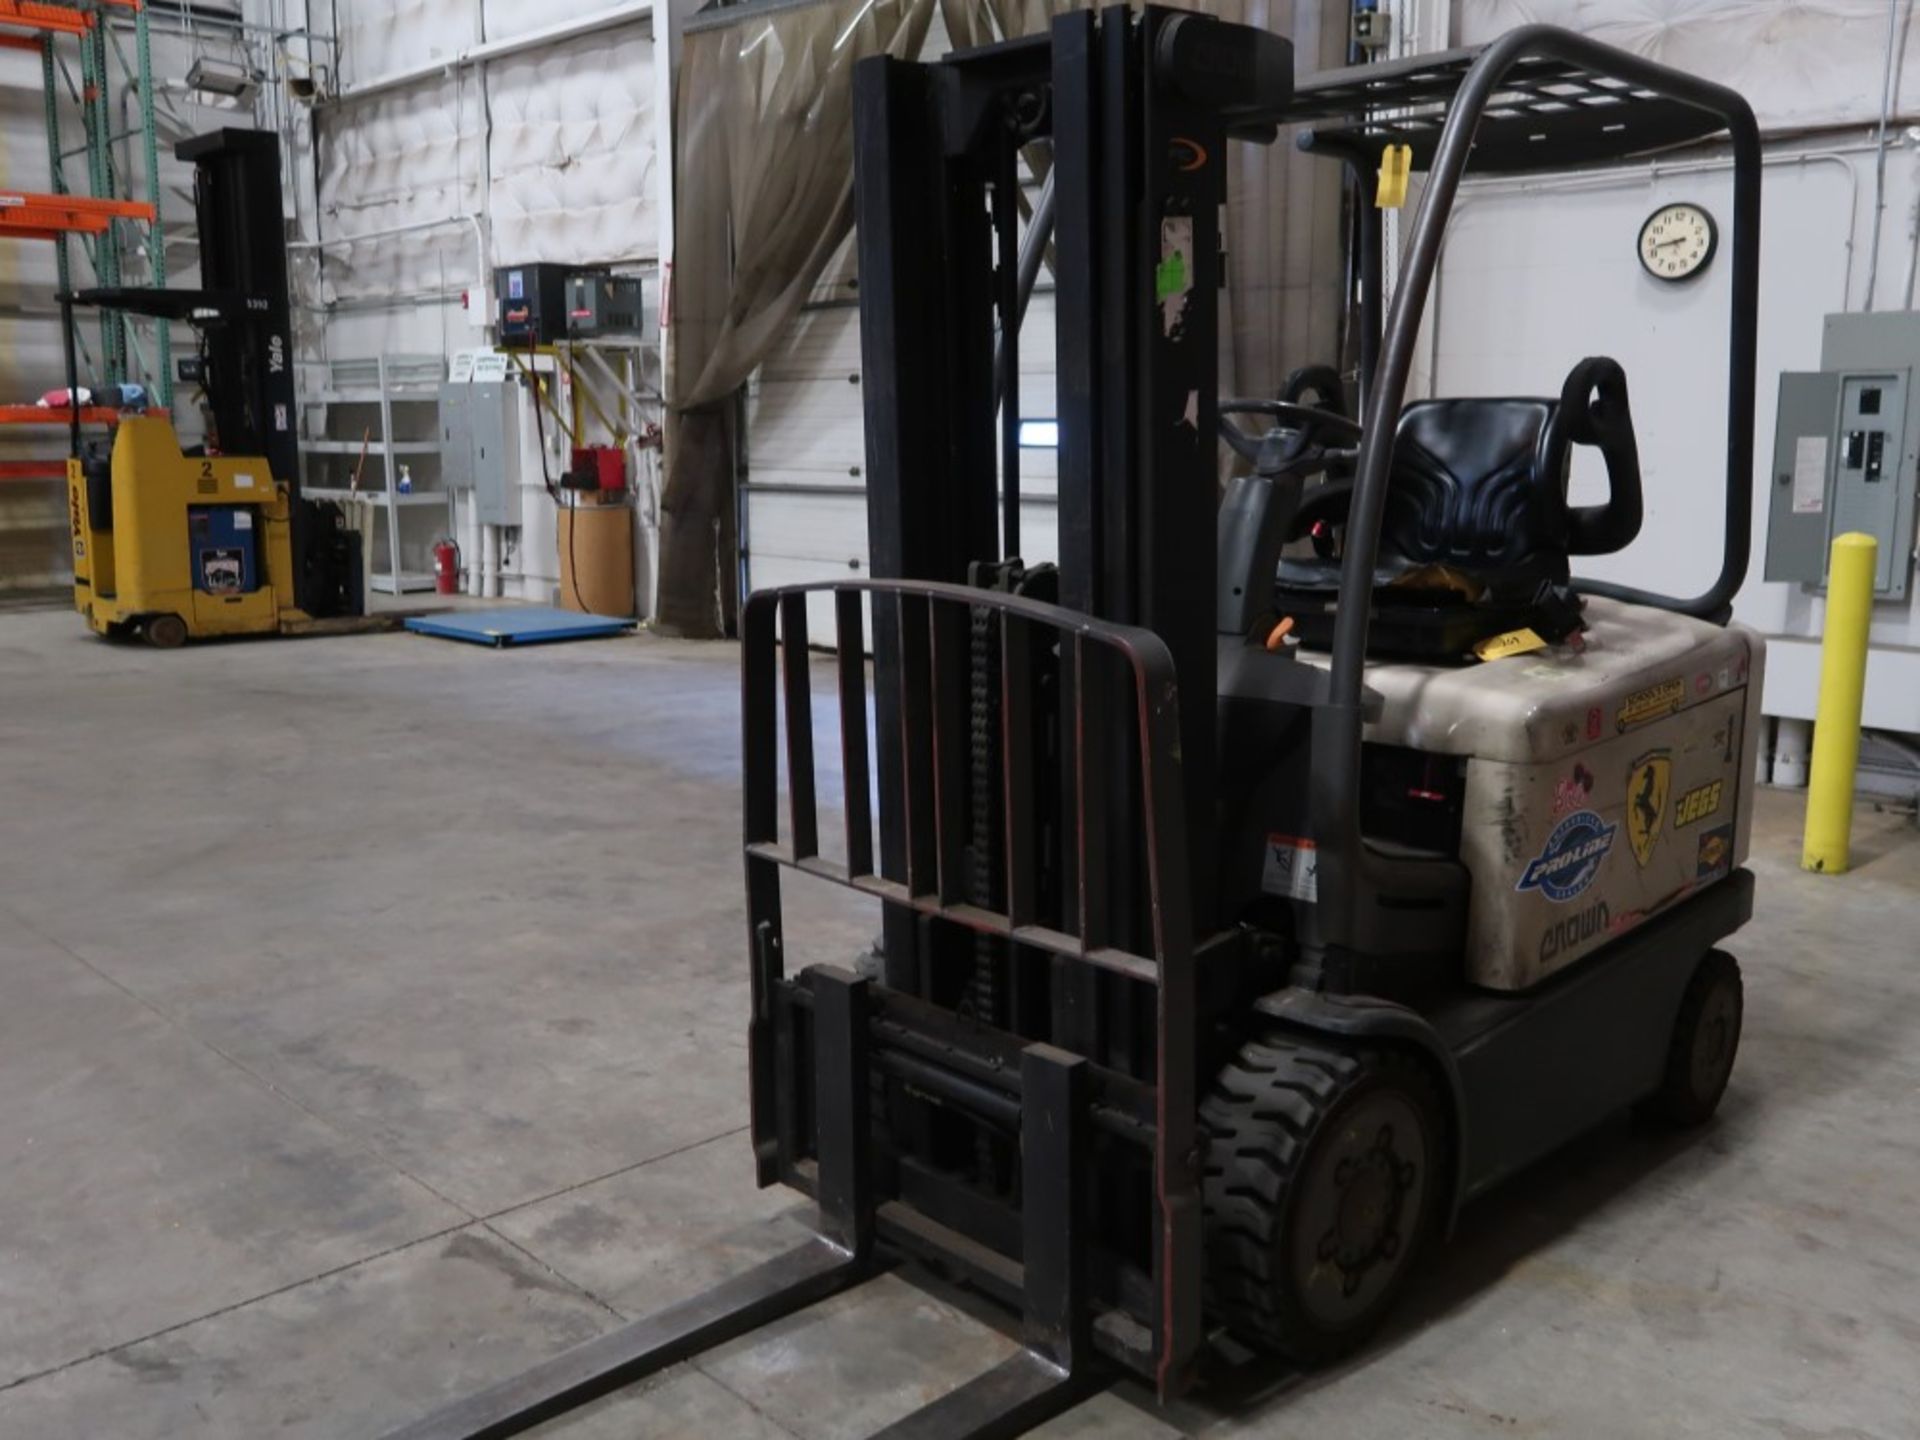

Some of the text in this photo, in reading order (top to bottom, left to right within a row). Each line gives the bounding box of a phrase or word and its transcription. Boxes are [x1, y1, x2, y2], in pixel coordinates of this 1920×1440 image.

[1664, 215, 1671, 225] 11
[1675, 211, 1686, 221] 12
[1652, 225, 1664, 235] 10
[1694, 226, 1702, 235] 2
[1690, 250, 1698, 259] 4
[1667, 262, 1676, 272] 6
[268, 335, 283, 373] Yale
[201, 462, 213, 477] 2
[1675, 781, 1721, 828] JEGS
